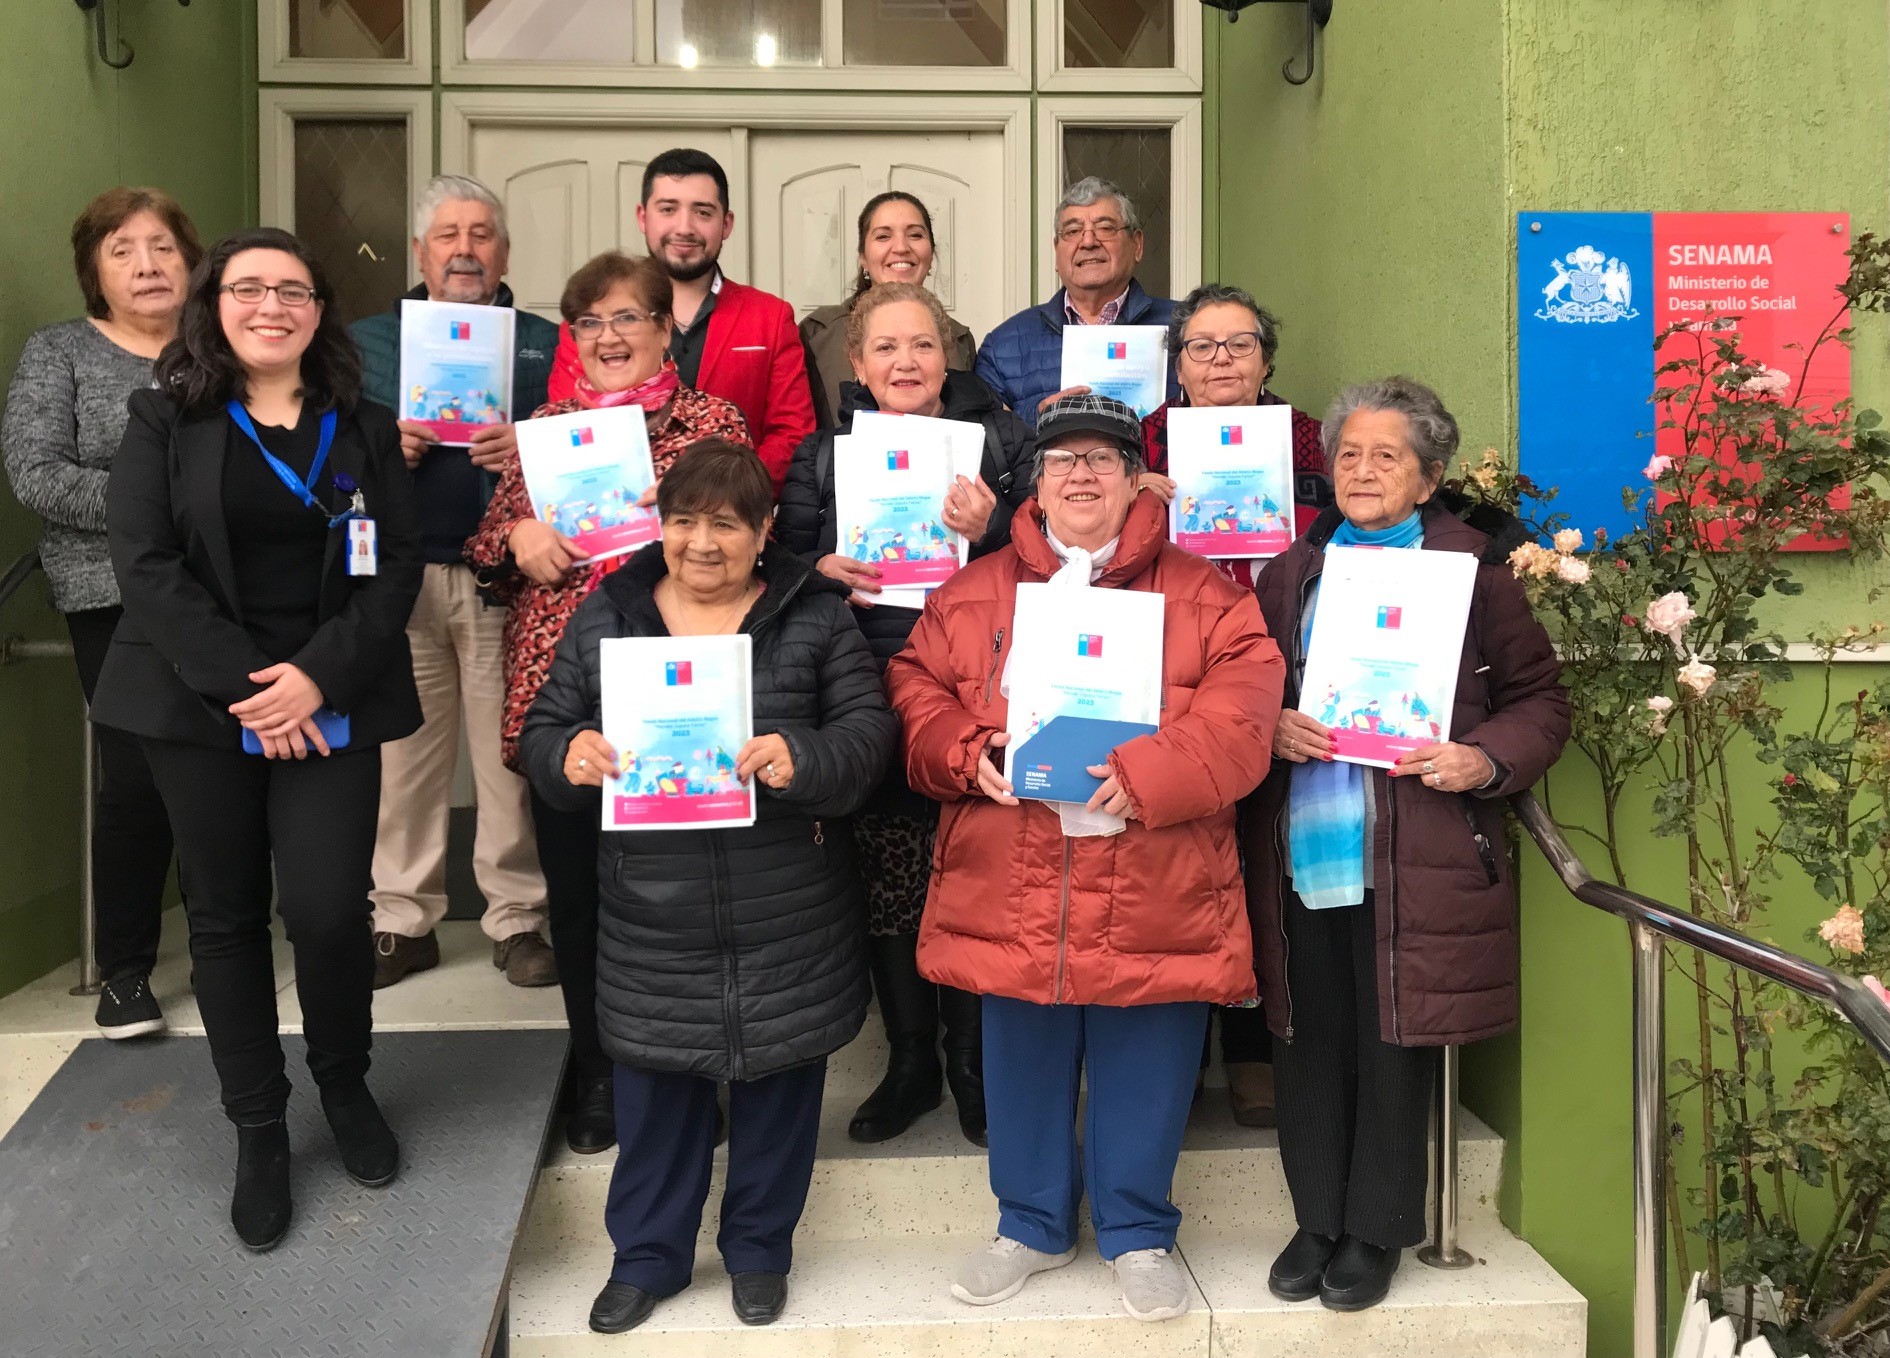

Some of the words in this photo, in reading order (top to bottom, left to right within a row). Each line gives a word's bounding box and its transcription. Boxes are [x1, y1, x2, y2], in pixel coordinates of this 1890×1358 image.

[1668, 244, 1773, 266] SENAMA
[1668, 275, 1747, 290] Ministerio
[1750, 275, 1770, 290] de
[1750, 295, 1797, 311] Social
[1077, 698, 1095, 706] 2023
[671, 729, 690, 737] 2023
